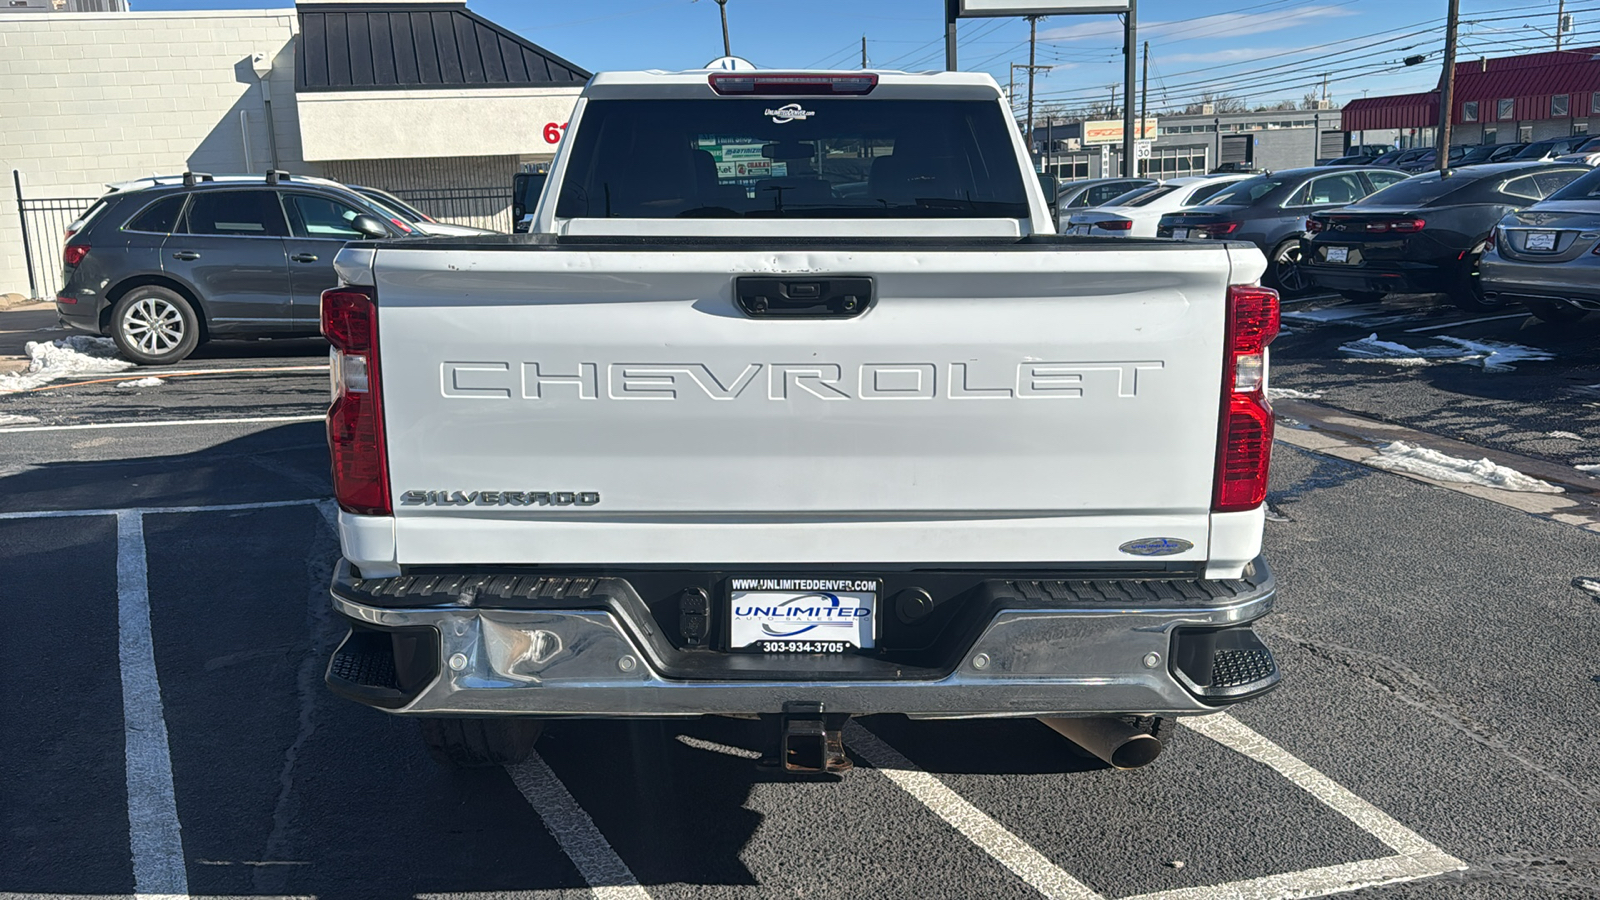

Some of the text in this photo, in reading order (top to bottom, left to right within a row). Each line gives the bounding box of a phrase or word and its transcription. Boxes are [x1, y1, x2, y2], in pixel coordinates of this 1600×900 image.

[1138, 149, 1150, 157] 30
[440, 360, 1164, 401] CHEVROLET
[400, 490, 600, 507] SILVERADO
[732, 579, 877, 591] WWW.UNLIMITEDDENVER.COM
[735, 607, 871, 617] UNLIMITED
[763, 642, 844, 653] 303-934-3705
